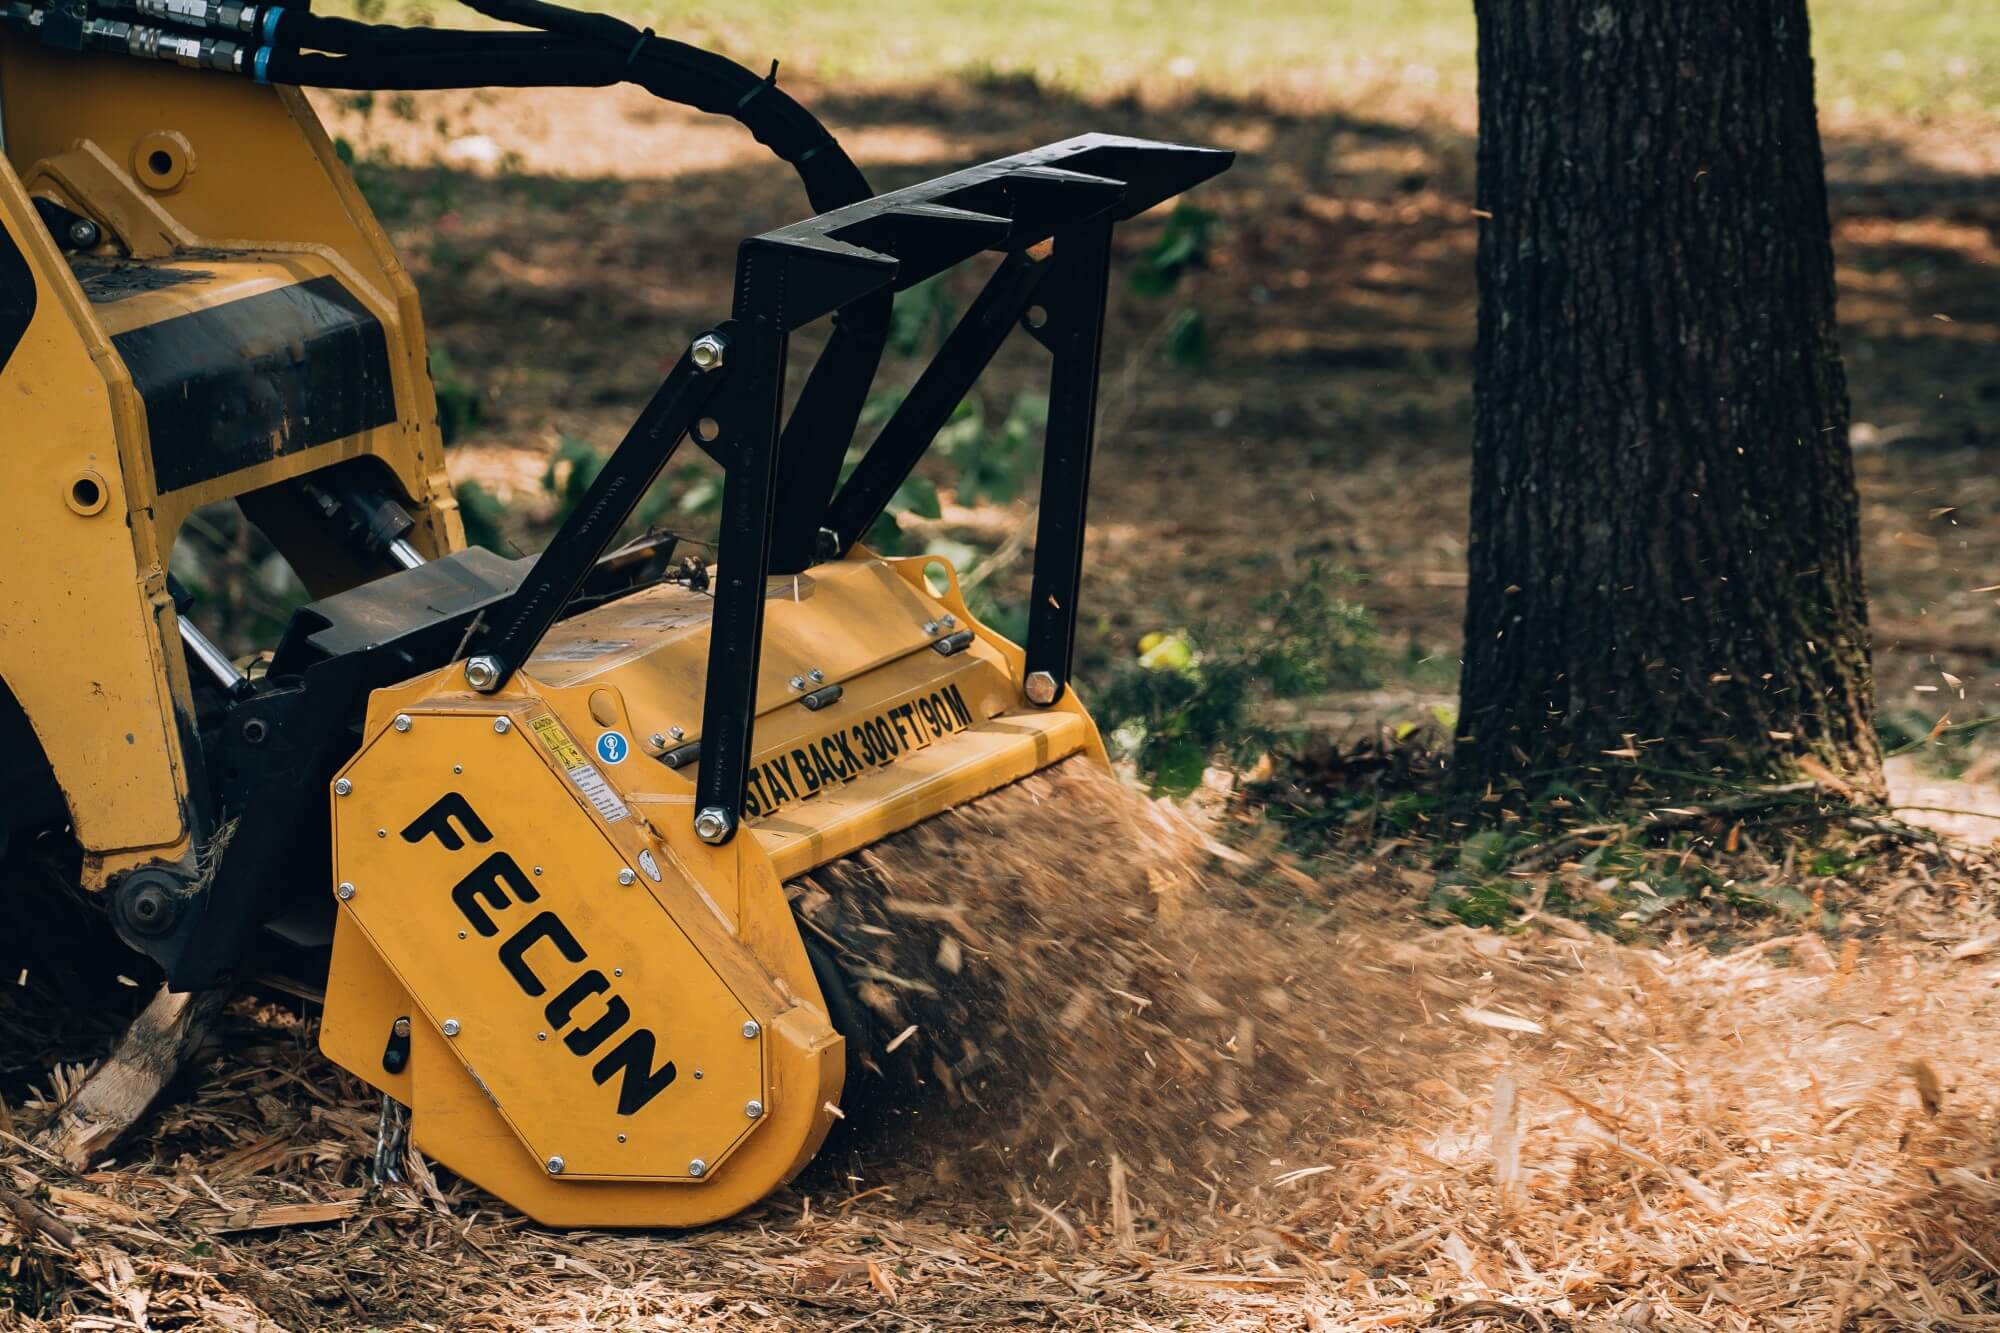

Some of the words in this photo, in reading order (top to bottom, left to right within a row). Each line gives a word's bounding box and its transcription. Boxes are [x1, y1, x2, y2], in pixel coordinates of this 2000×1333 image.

[790, 730, 863, 791] BACK
[853, 715, 899, 767] 300
[400, 792, 677, 1115] FECON
